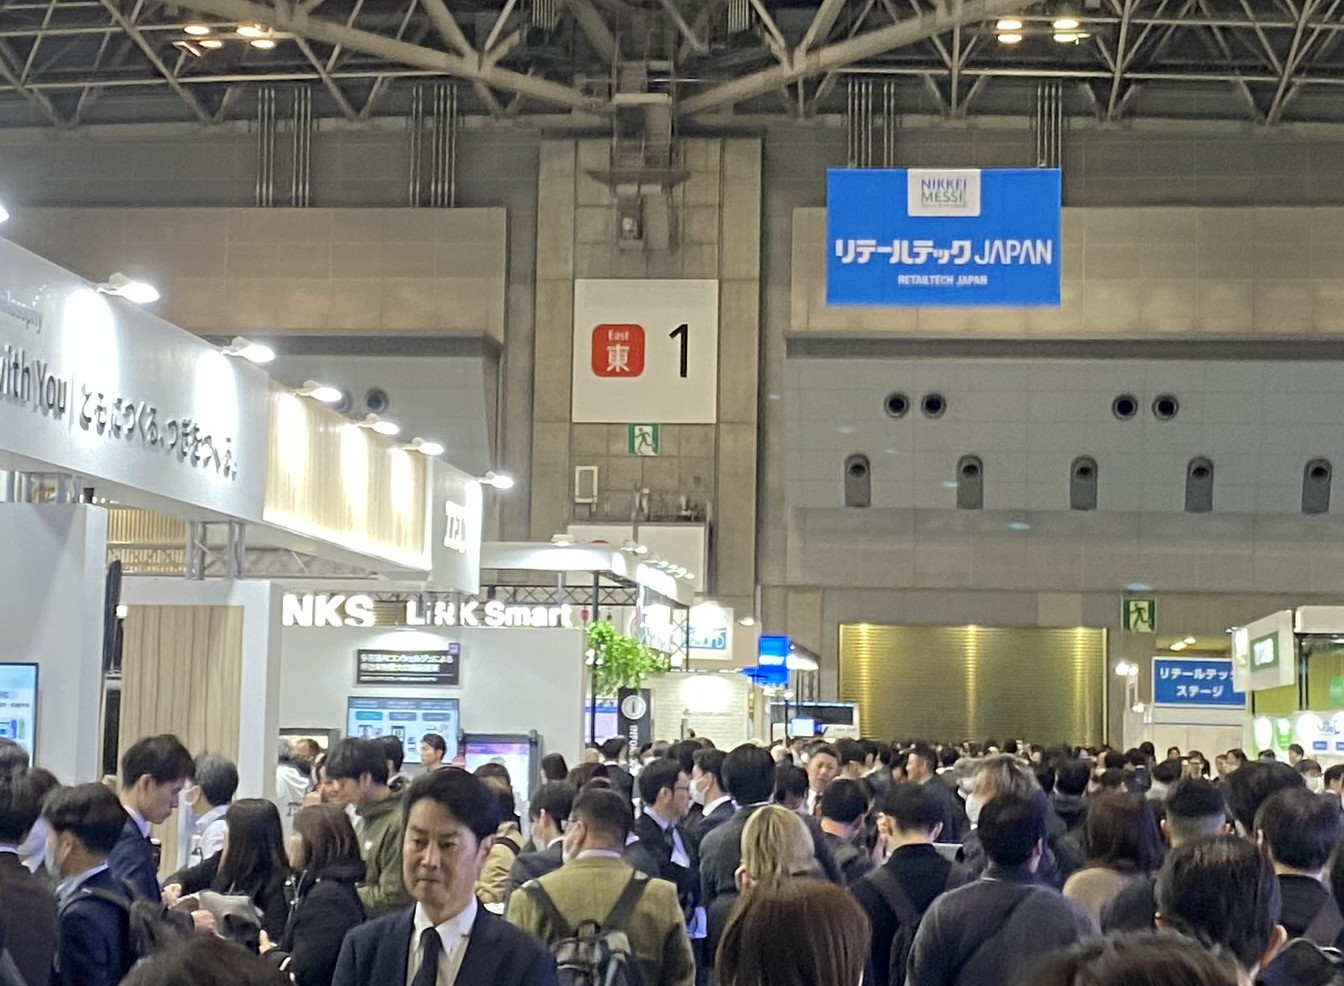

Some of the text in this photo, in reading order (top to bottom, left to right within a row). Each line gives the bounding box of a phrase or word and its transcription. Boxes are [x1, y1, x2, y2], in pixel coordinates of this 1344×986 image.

[836, 239, 1053, 264] リテールテック JAPAN
[956, 274, 988, 286] JAPAN
[607, 329, 630, 342] East
[606, 343, 630, 373] 東
[669, 324, 689, 378] 1
[33, 360, 67, 414] You
[282, 594, 376, 628] NKS
[484, 600, 573, 628] Smart
[1176, 685, 1224, 697] ステージ
